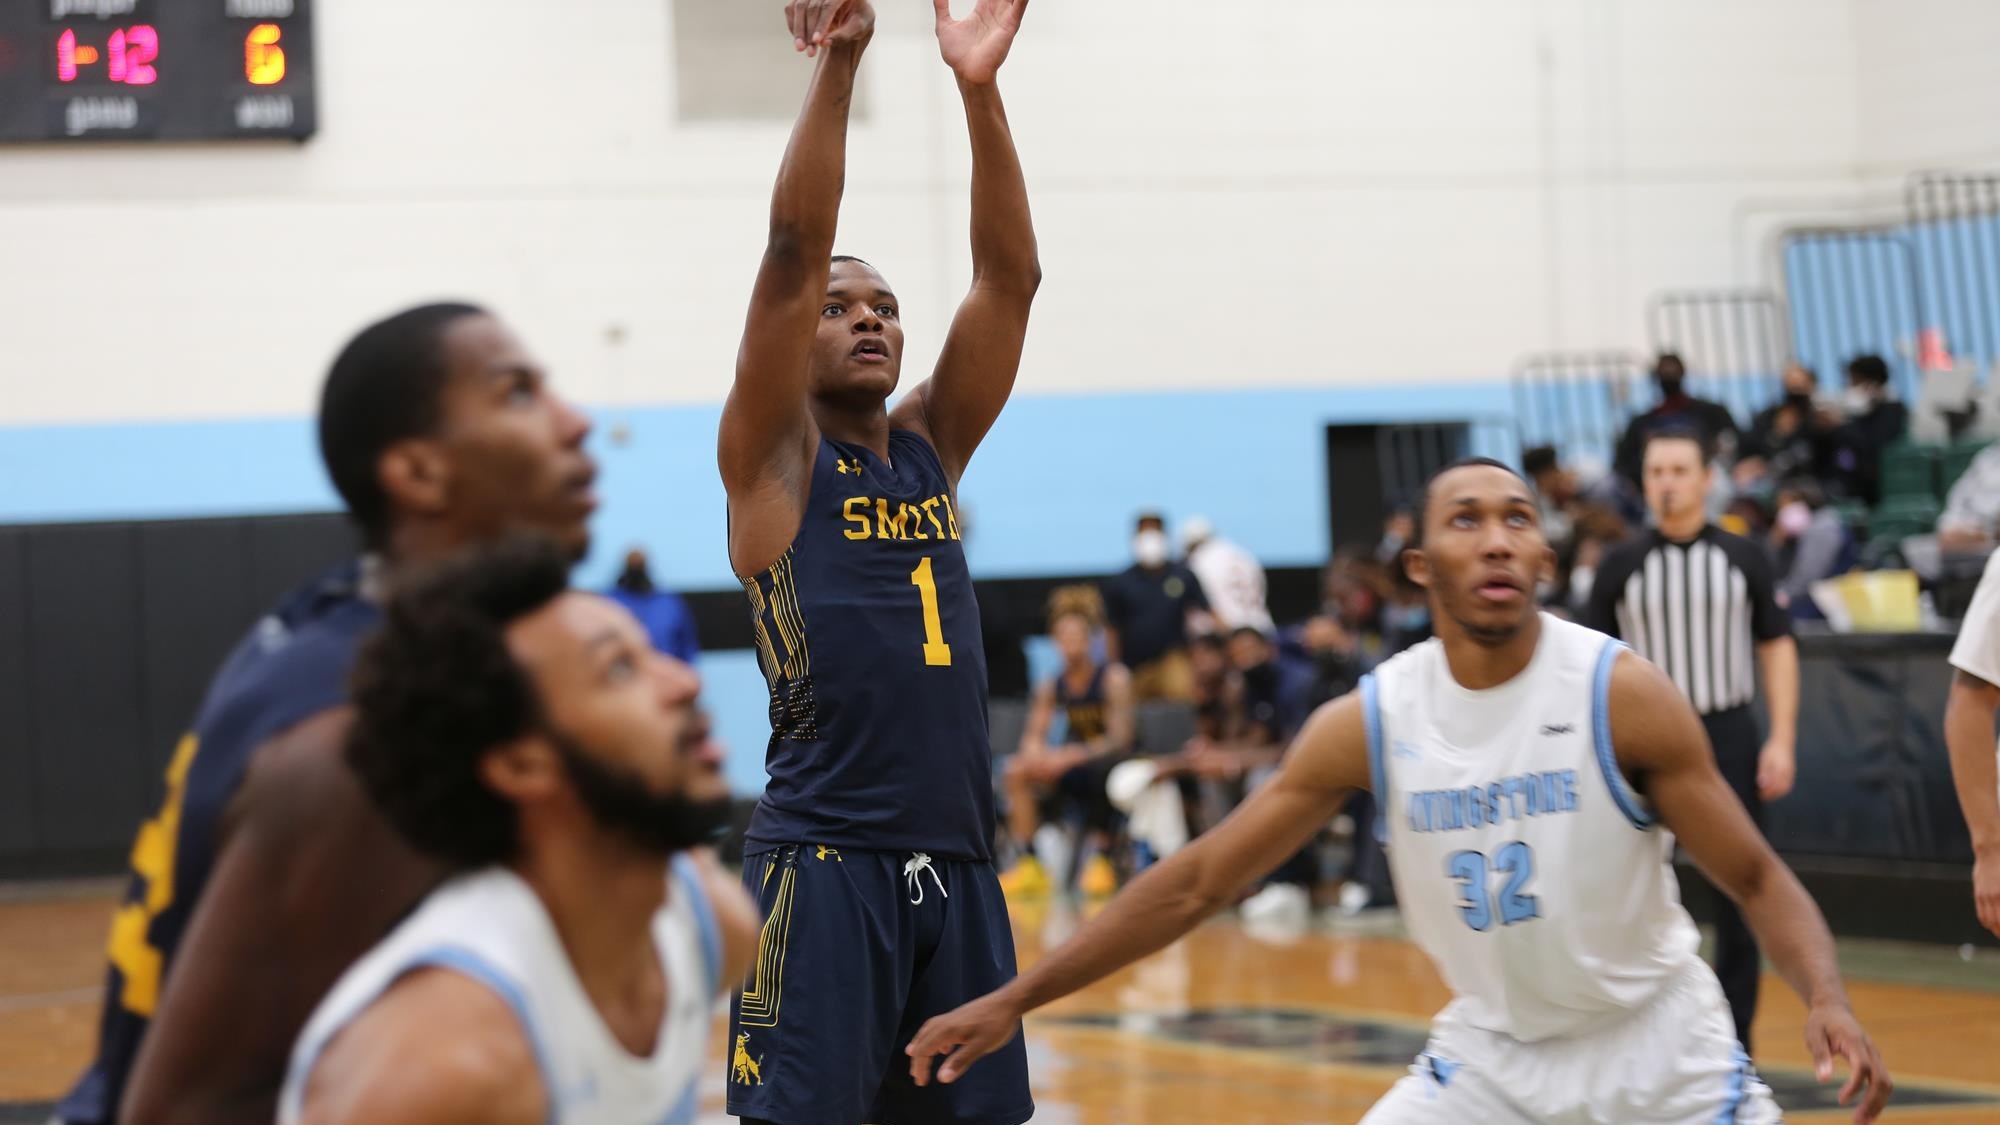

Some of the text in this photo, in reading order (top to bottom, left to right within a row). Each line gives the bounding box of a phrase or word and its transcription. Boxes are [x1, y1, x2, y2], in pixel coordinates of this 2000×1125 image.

[244, 23, 286, 84] 6
[843, 494, 961, 541] SMITH
[911, 557, 951, 666] 1
[1446, 840, 1542, 930] 32
